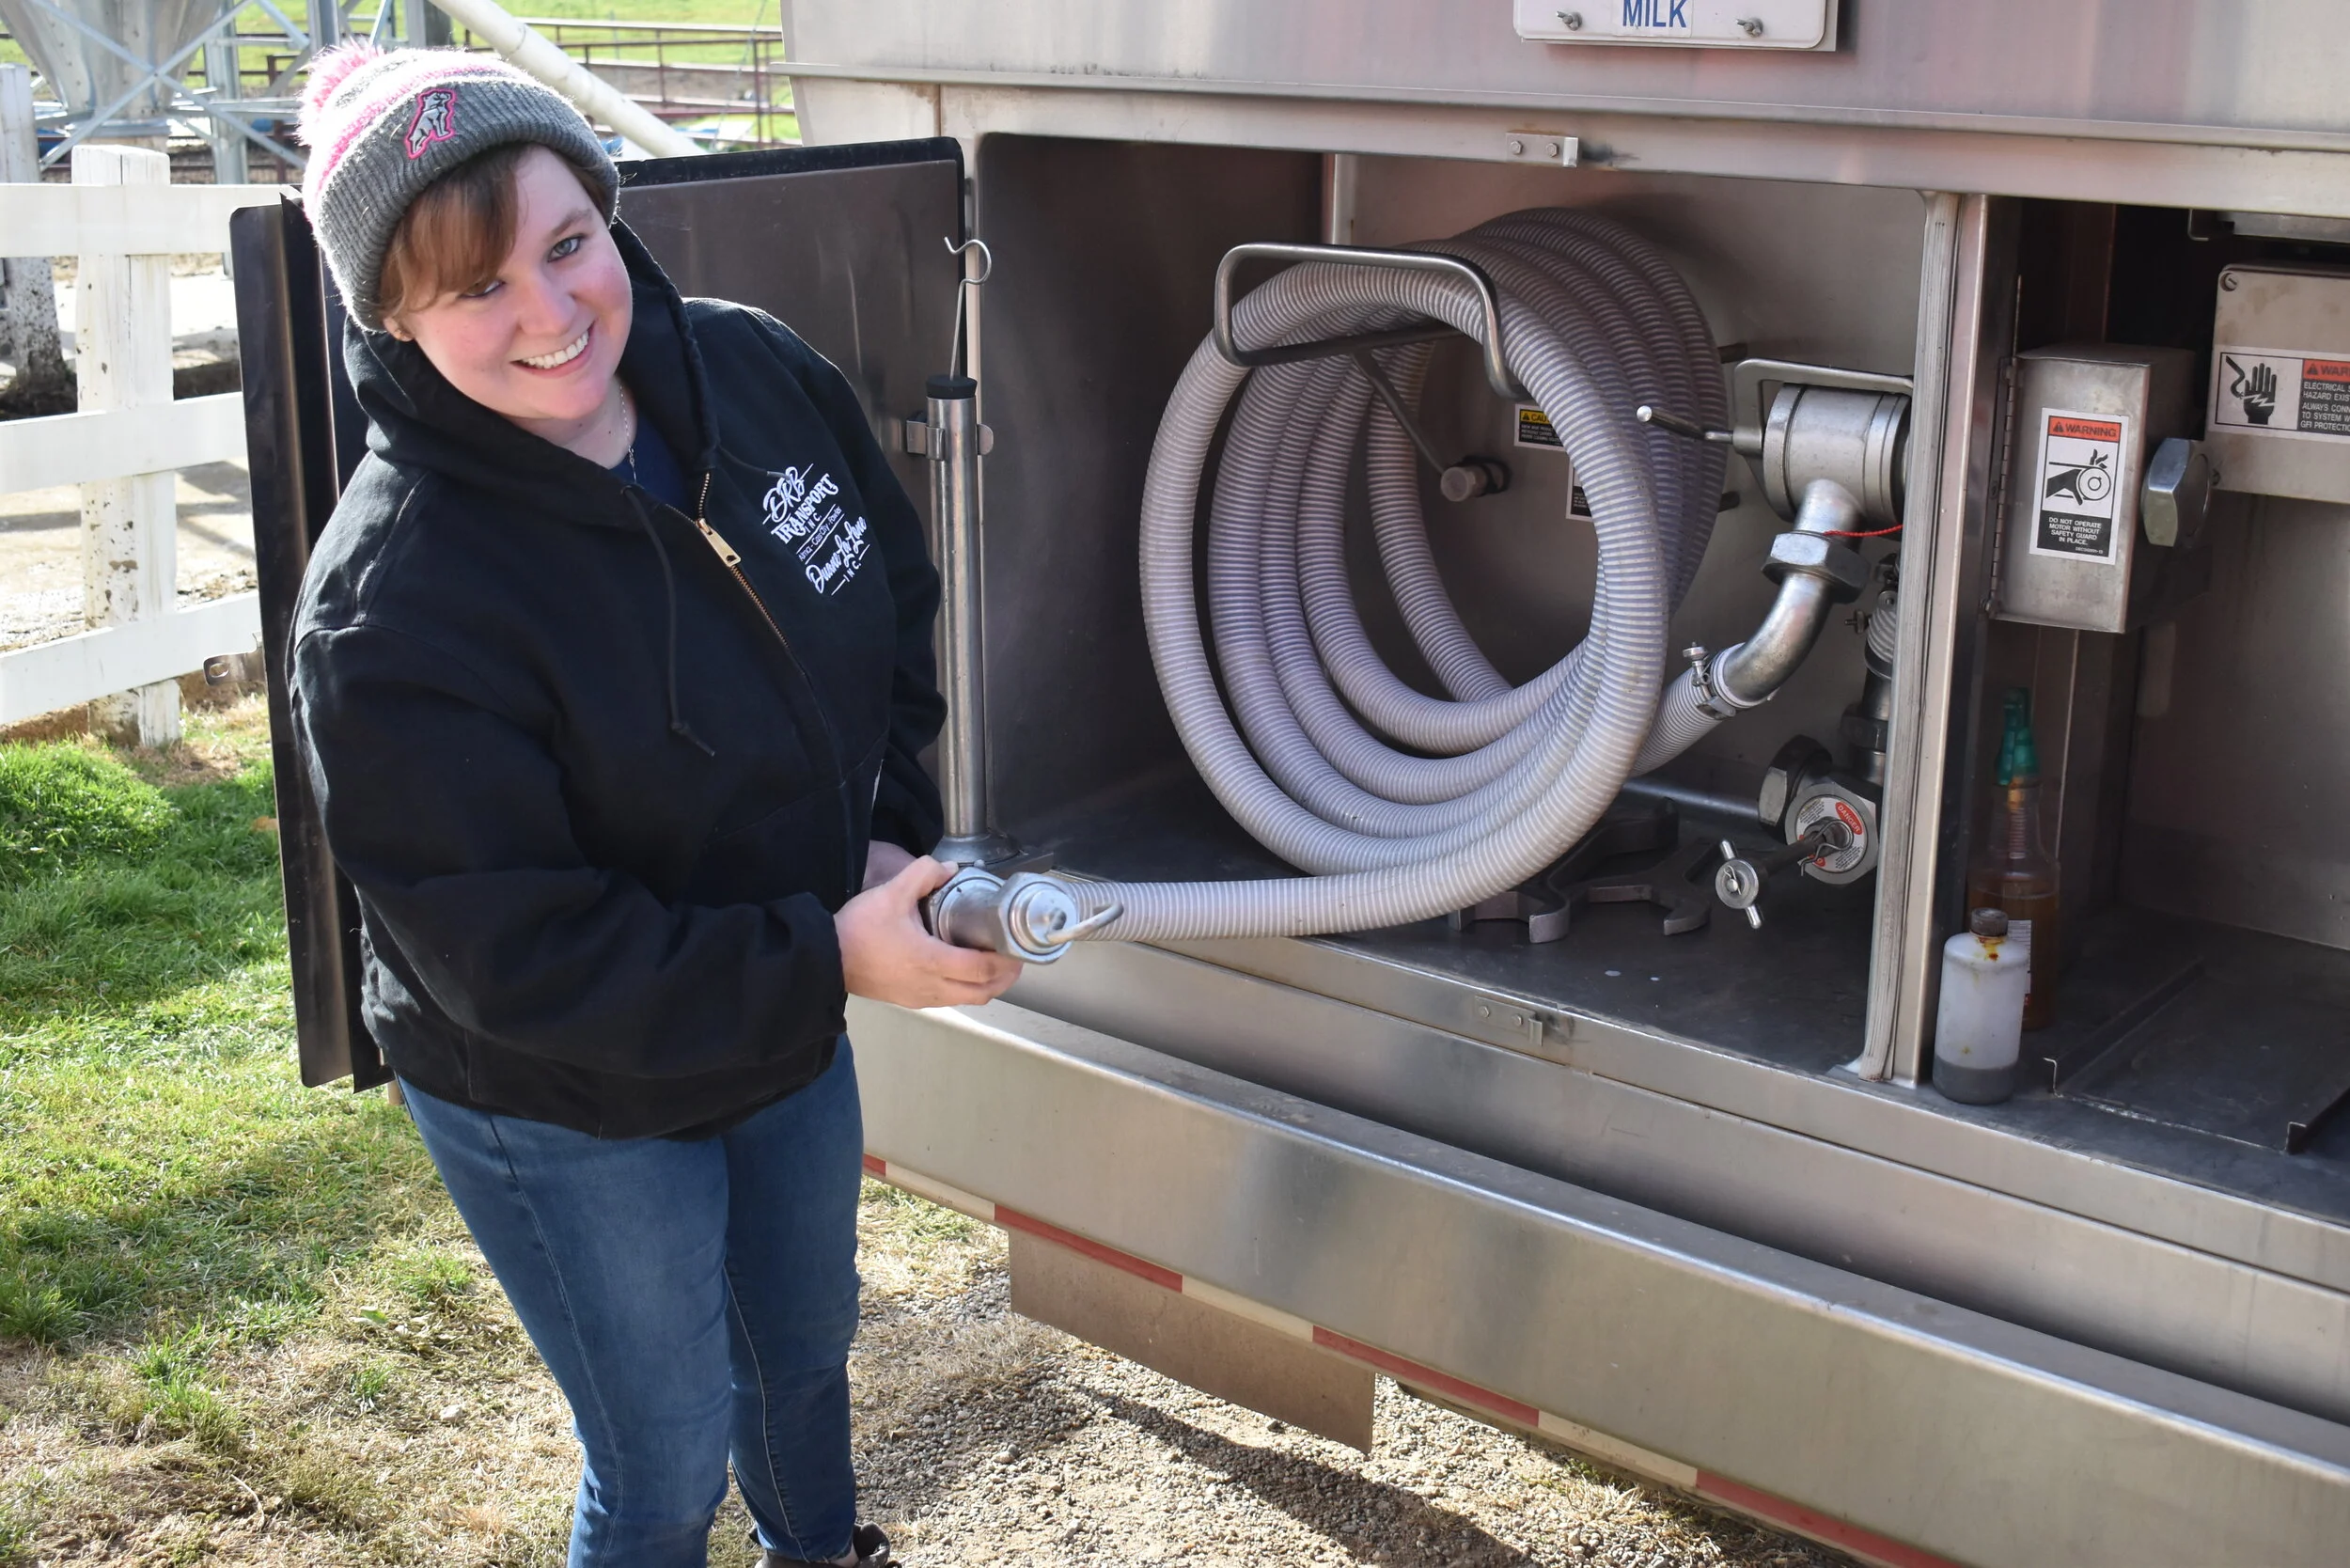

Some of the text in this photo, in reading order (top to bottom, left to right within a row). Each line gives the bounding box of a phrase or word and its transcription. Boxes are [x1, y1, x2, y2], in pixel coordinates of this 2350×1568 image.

[1622, 0, 1687, 28] MILK
[2304, 382, 2345, 392] ELECTRICAL
[2304, 391, 2331, 400] HAZARD
[2302, 402, 2328, 411] ALWAYS
[1531, 414, 1549, 422] CAU
[2313, 413, 2342, 422] SYSTEM
[2301, 420, 2312, 429] GFI
[2065, 423, 2117, 437] WARNING
[771, 473, 838, 544] TRANSPORT
[805, 513, 822, 533] INC.
[2075, 520, 2102, 528] OPERATE
[2073, 525, 2100, 534] WITHOUT
[806, 552, 842, 594] Duane
[843, 560, 861, 582] INC.
[1838, 806, 1860, 832] DANGER
